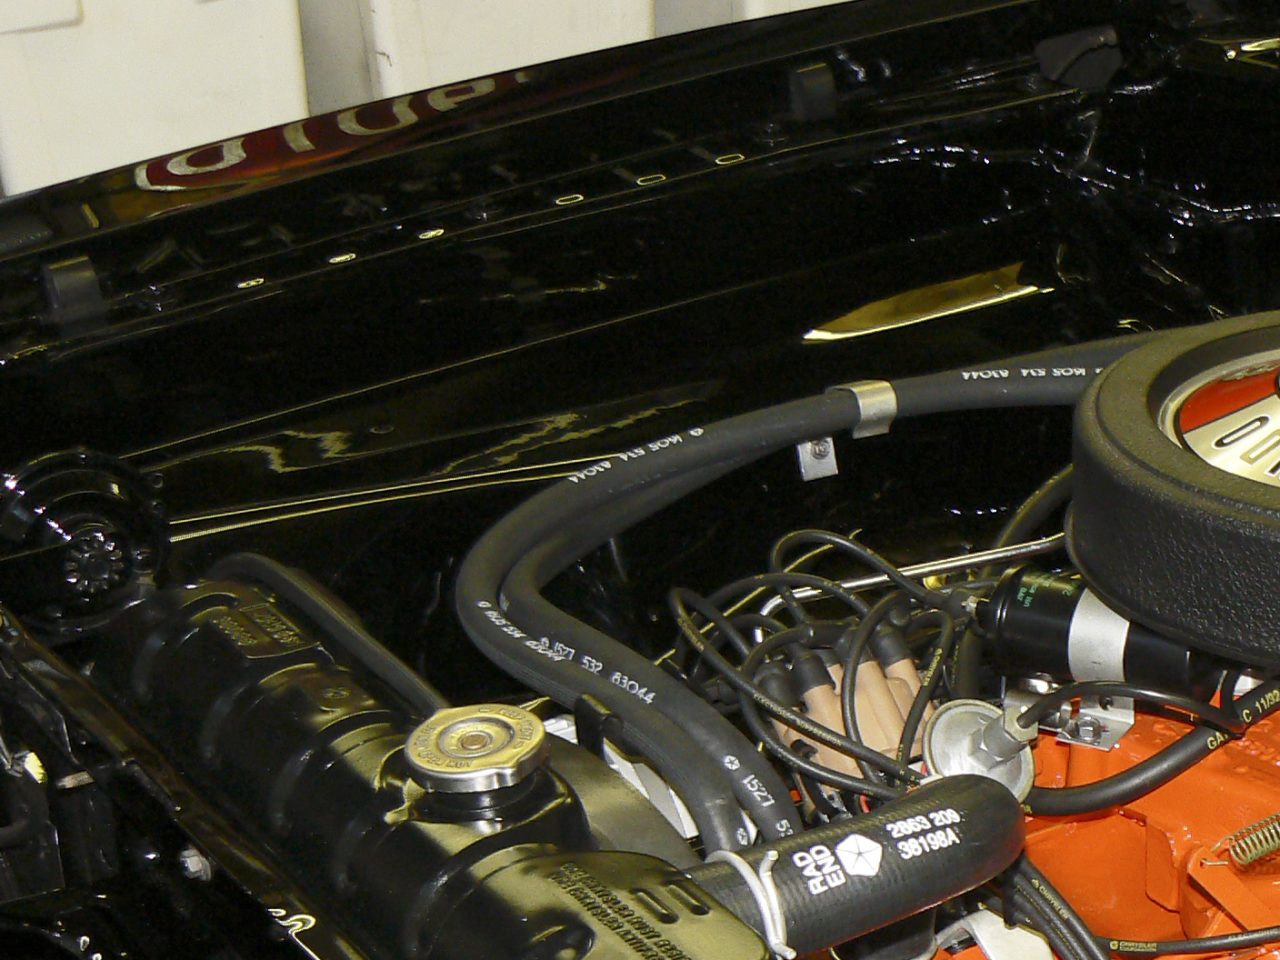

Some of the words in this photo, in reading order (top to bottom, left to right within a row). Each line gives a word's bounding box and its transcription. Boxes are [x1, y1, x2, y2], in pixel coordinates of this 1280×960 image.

[610, 672, 656, 704] 83044
[743, 774, 775, 807] 1527
[886, 815, 931, 838] 2863
[928, 808, 960, 827] 209
[897, 827, 960, 860] 38198A
[792, 851, 829, 895] RAD
[809, 844, 847, 888] END
